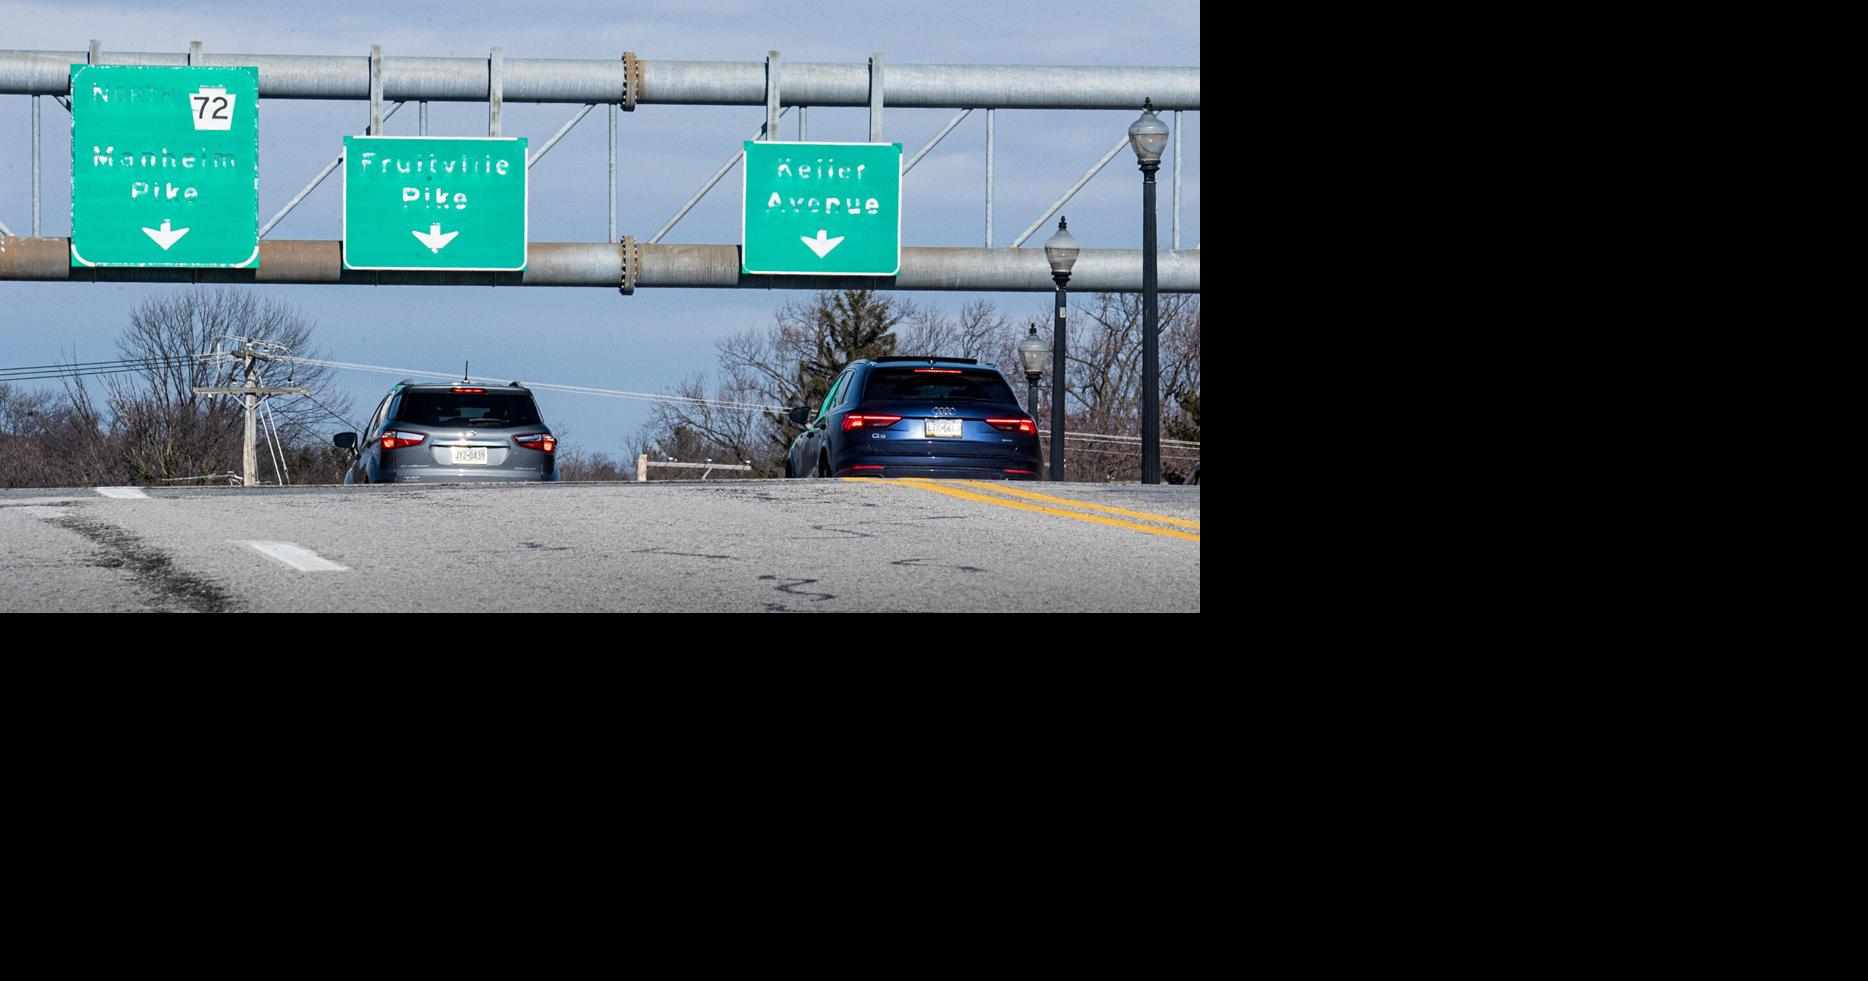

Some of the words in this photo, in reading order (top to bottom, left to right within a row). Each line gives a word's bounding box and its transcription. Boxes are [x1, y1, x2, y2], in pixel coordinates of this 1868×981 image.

[193, 96, 229, 120] 72
[93, 145, 236, 168] Manheim
[361, 152, 510, 176] Fruitville
[777, 157, 866, 180] Keller
[131, 181, 199, 204] Pike
[402, 186, 468, 210] Pike
[765, 192, 880, 215] Avenue
